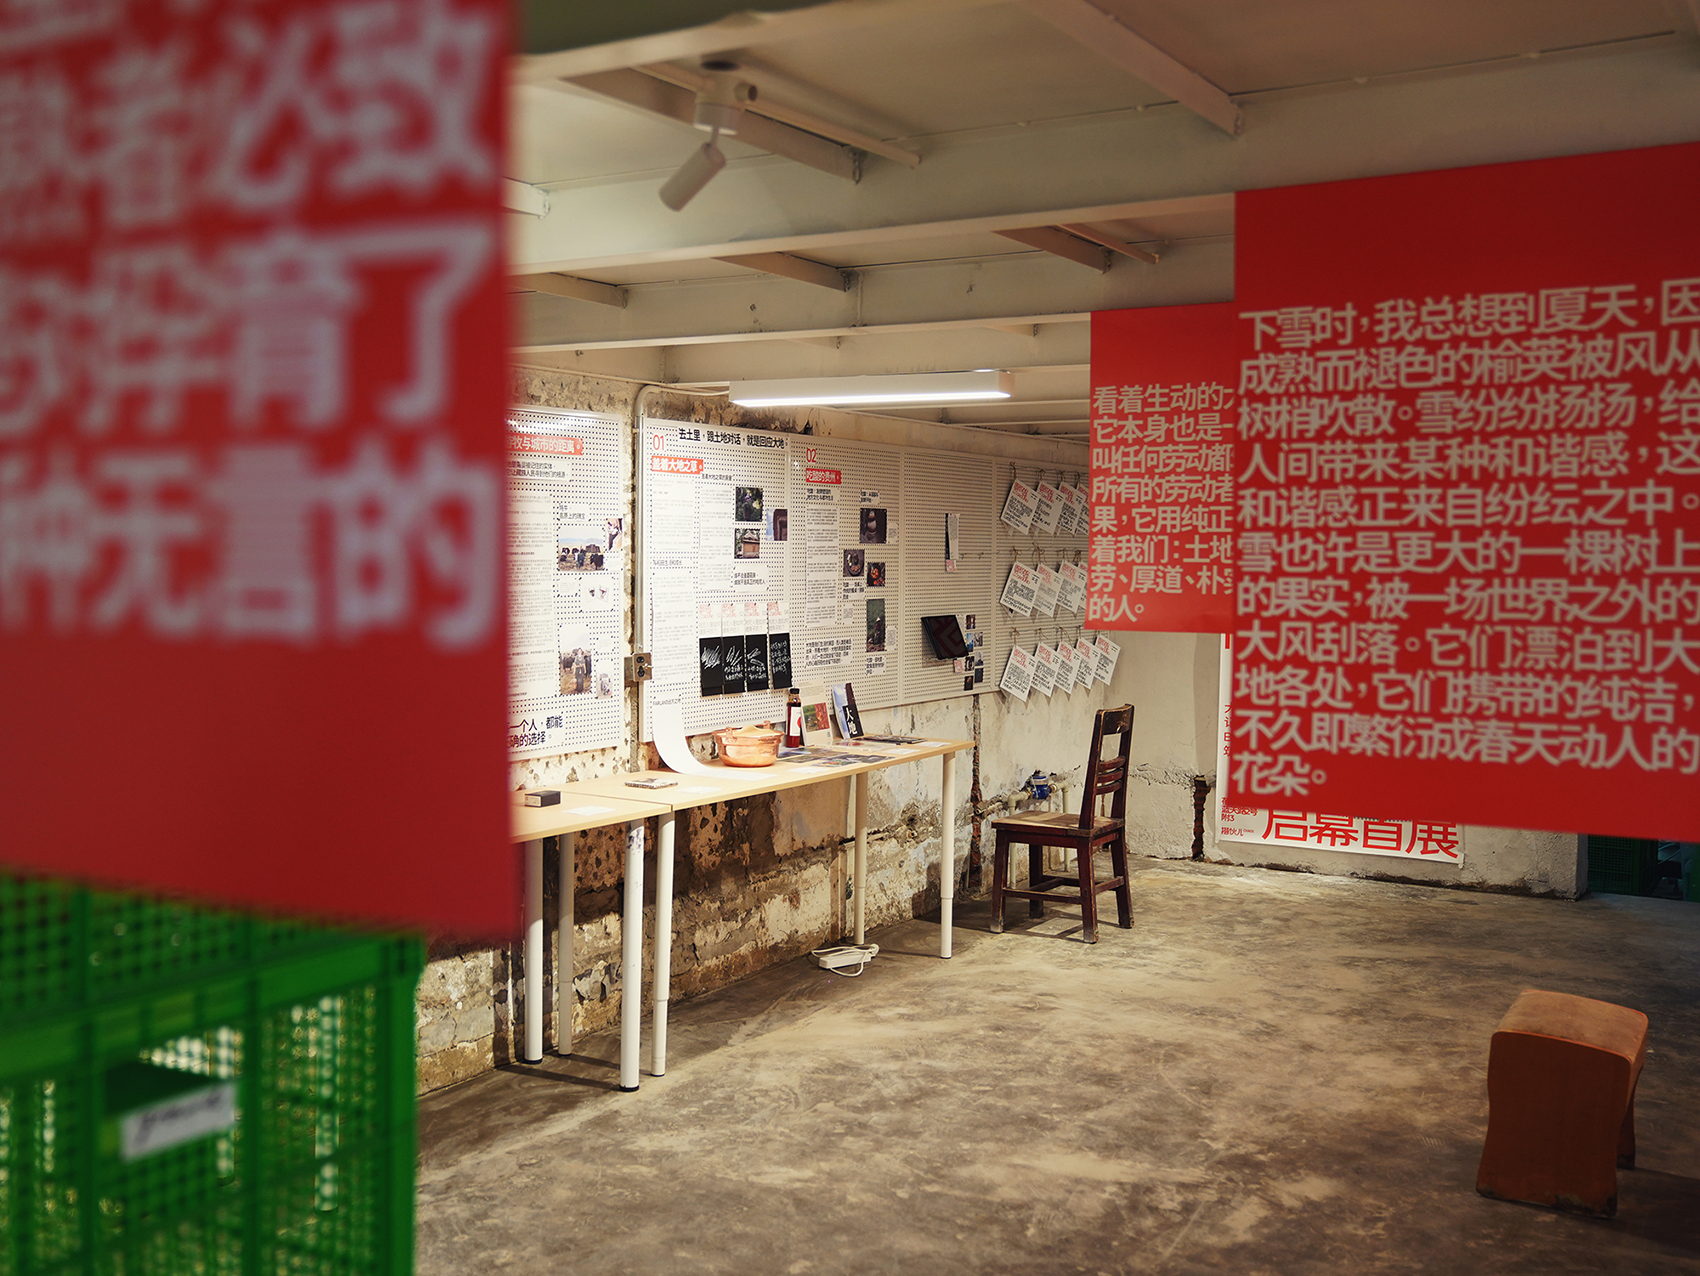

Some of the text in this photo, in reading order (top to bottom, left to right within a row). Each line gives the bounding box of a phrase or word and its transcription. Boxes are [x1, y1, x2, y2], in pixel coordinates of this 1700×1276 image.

[1236, 376, 1700, 441] 树梢吹散。雪纷纷扬扬，给
[652, 434, 665, 451] 01
[806, 448, 817, 463] 02
[1238, 428, 1700, 485] 人间带来某种和谐感，这
[1092, 504, 1233, 535] 果，它用纯正
[1237, 477, 1700, 530] 和谐感正来自纷纭之中。
[1237, 528, 1700, 575] 雪也许是更大的一棵树上
[1088, 594, 1144, 623] 的人。
[1237, 577, 1700, 625] 的果实，被一场世界之外的
[1236, 620, 1700, 675] 大风刮落。它们漂泊到大
[1234, 663, 1694, 725] 地各处，它们携带的纯洁，
[1233, 709, 1700, 776] 不久即繁衍成春天动人的
[1231, 751, 1327, 797] 花朵。
